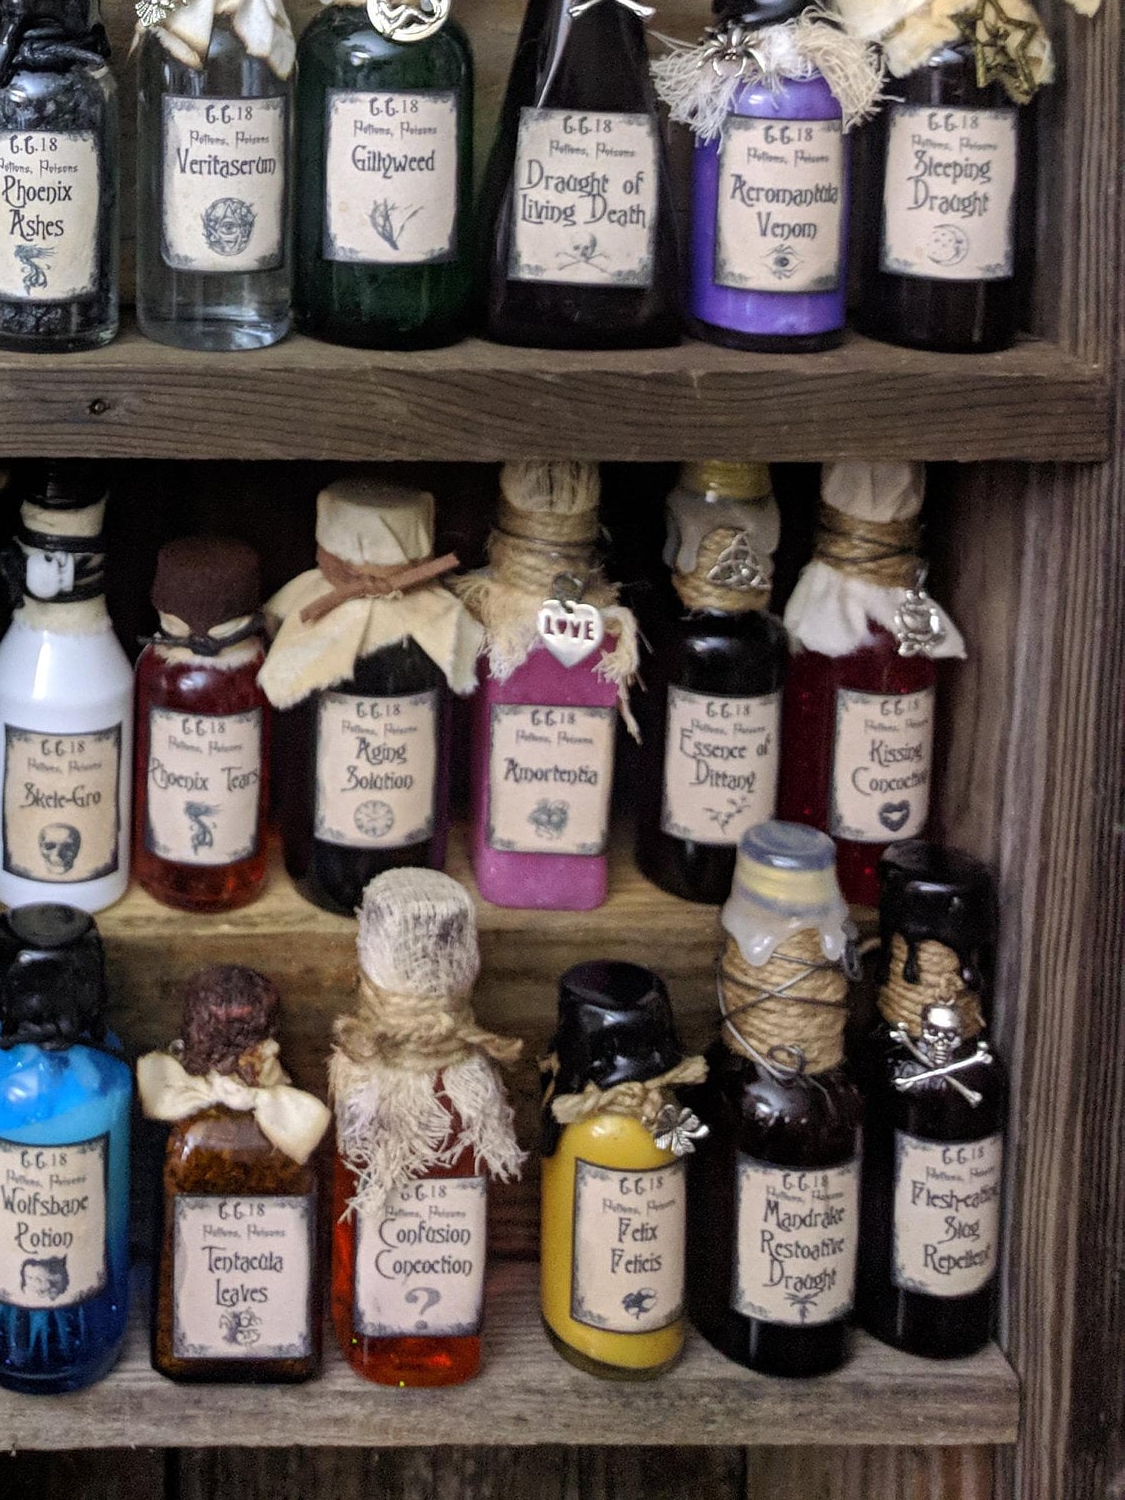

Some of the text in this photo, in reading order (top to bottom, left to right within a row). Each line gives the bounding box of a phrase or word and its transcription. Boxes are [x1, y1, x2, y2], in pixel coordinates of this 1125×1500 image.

[177, 148, 276, 178] Veritaserum
[351, 145, 435, 179] Gillyweed
[907, 150, 991, 184] Sleeping
[2, 175, 73, 209] Phoenix
[519, 159, 644, 198] Draught of
[521, 194, 646, 229] Living Death
[907, 177, 989, 218] Draught
[9, 209, 64, 241] Ashes
[756, 212, 817, 240] Venom
[355, 737, 407, 765] Aging
[679, 727, 746, 759] Essence
[148, 758, 208, 791] Phoenix
[340, 766, 413, 792] Solution
[504, 757, 598, 785] Amortentia
[689, 758, 756, 793] Dittany
[19, 782, 102, 809] Skele-Gro
[0, 1184, 89, 1217] Wolfsbane
[763, 1199, 845, 1232] Mandrake
[14, 1222, 74, 1254] Potion
[379, 1218, 471, 1248] Confusion
[618, 1217, 658, 1243] Felix
[201, 1246, 283, 1273] Tentacula
[375, 1249, 472, 1280] Concoction
[611, 1248, 662, 1274] Felicis
[763, 1258, 836, 1292] Draught
[216, 1278, 268, 1308] Leaves
